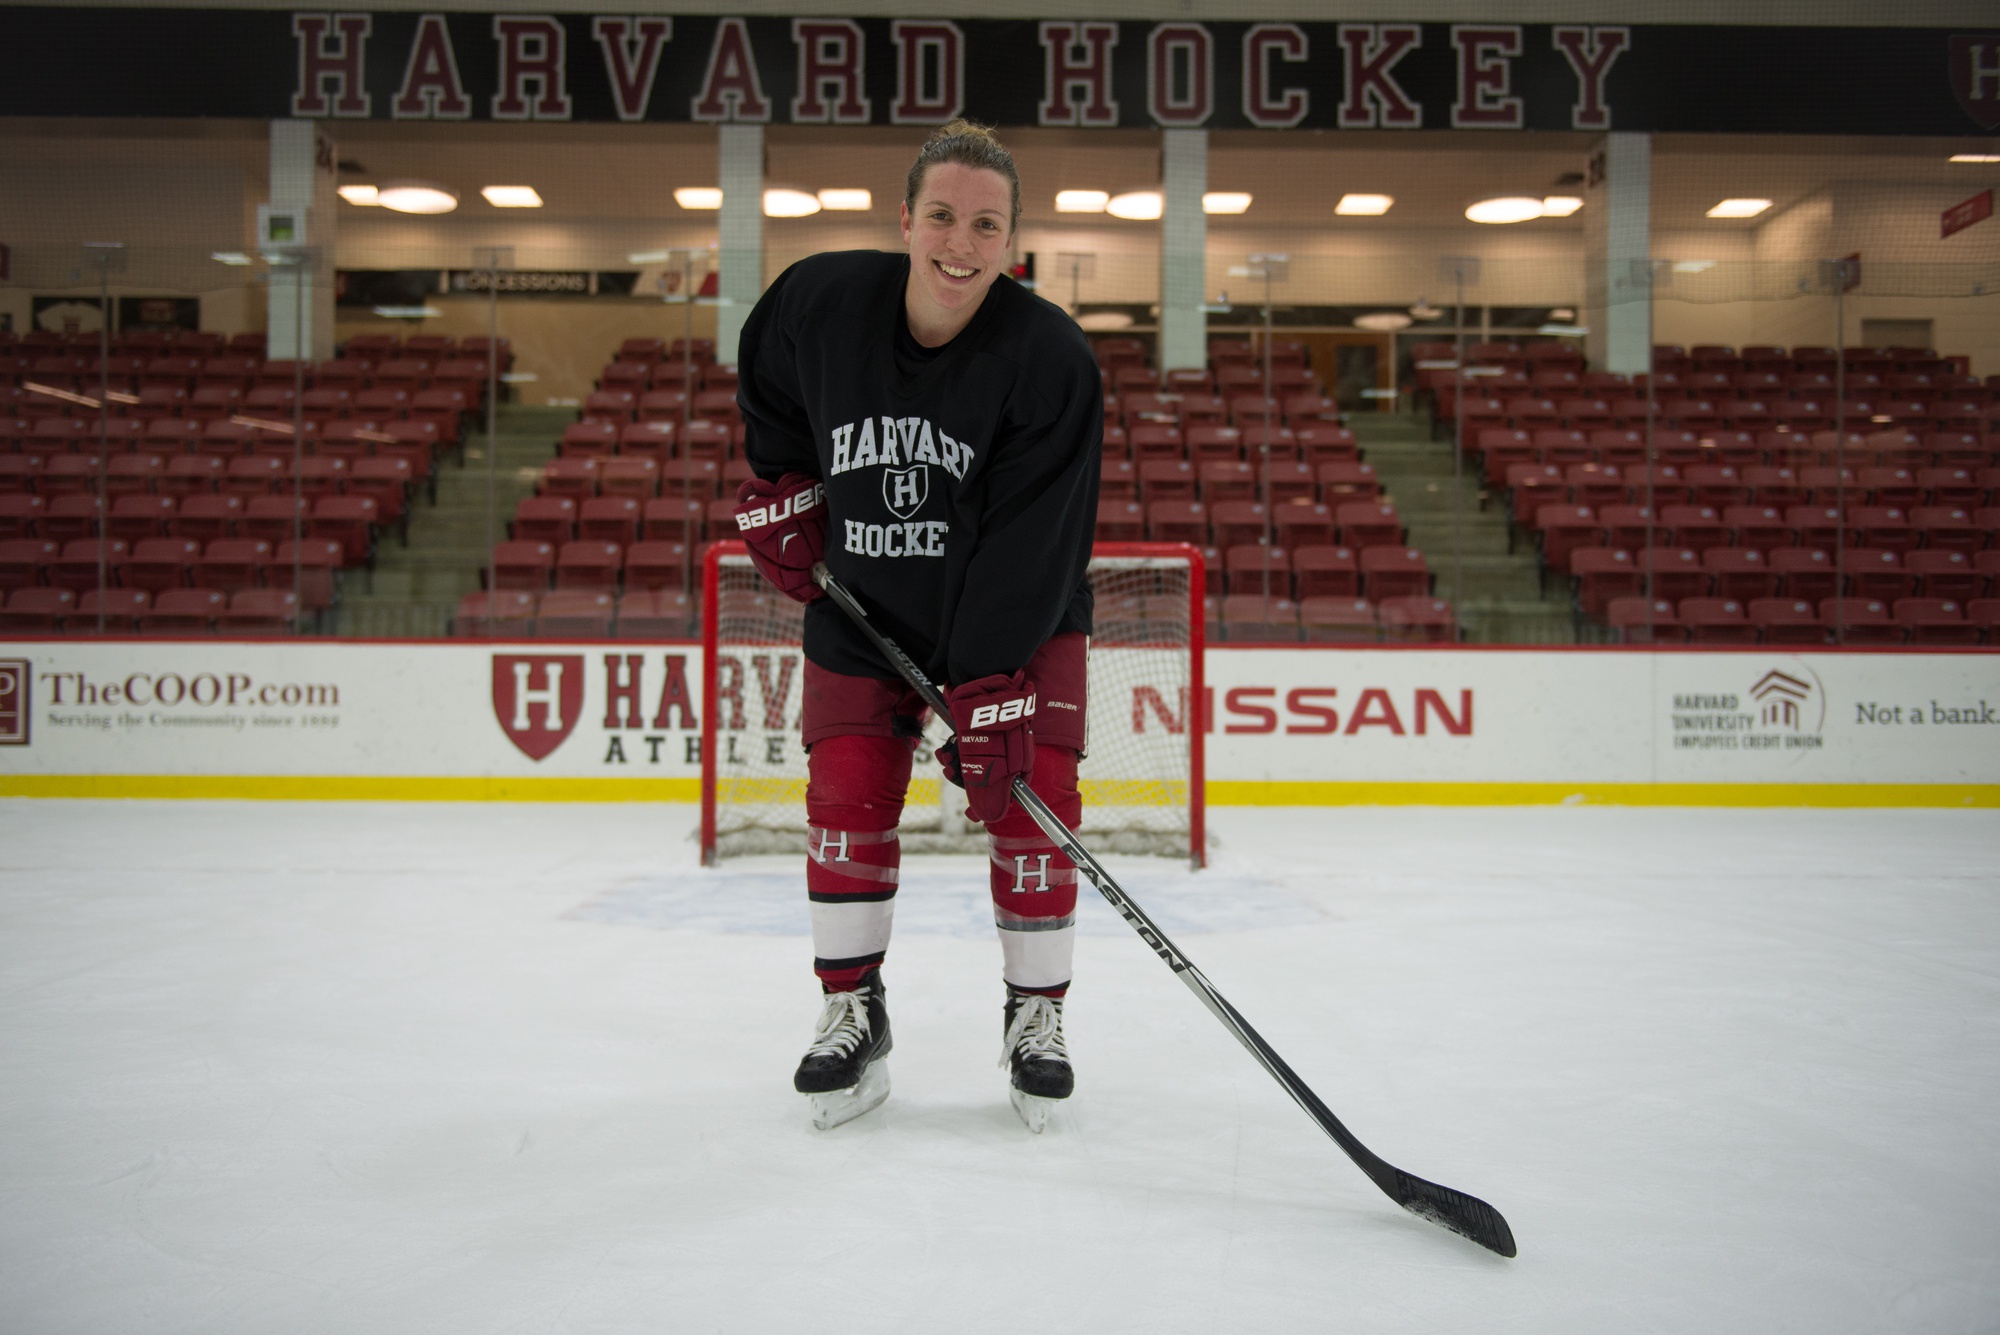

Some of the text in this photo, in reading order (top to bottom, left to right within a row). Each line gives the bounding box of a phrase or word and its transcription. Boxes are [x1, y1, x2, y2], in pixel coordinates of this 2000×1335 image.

[293, 13, 1631, 129] HARVARD HOCKEY
[453, 272, 587, 292] CONCESSIONS
[894, 471, 919, 508] H
[844, 519, 949, 558] HOCKE
[881, 637, 932, 686] EASTON
[40, 672, 340, 706] TheCOOP.com
[513, 661, 563, 731] H
[603, 654, 803, 730] HARV
[1672, 695, 1739, 710] HARVARD
[47, 711, 110, 729] Serving
[117, 711, 145, 727] the
[149, 711, 247, 730] Community
[253, 714, 293, 727] since
[970, 692, 1037, 729] BAU
[1132, 686, 1473, 735] NISSAN
[1671, 714, 1755, 731] UNIVERSITY
[1855, 699, 2000, 725] Not a bank.
[1673, 734, 1823, 749] EMPLOYEES CREDIT UNION
[816, 829, 852, 863] H
[1011, 853, 1053, 893] H
[1062, 843, 1186, 973] EASTON
